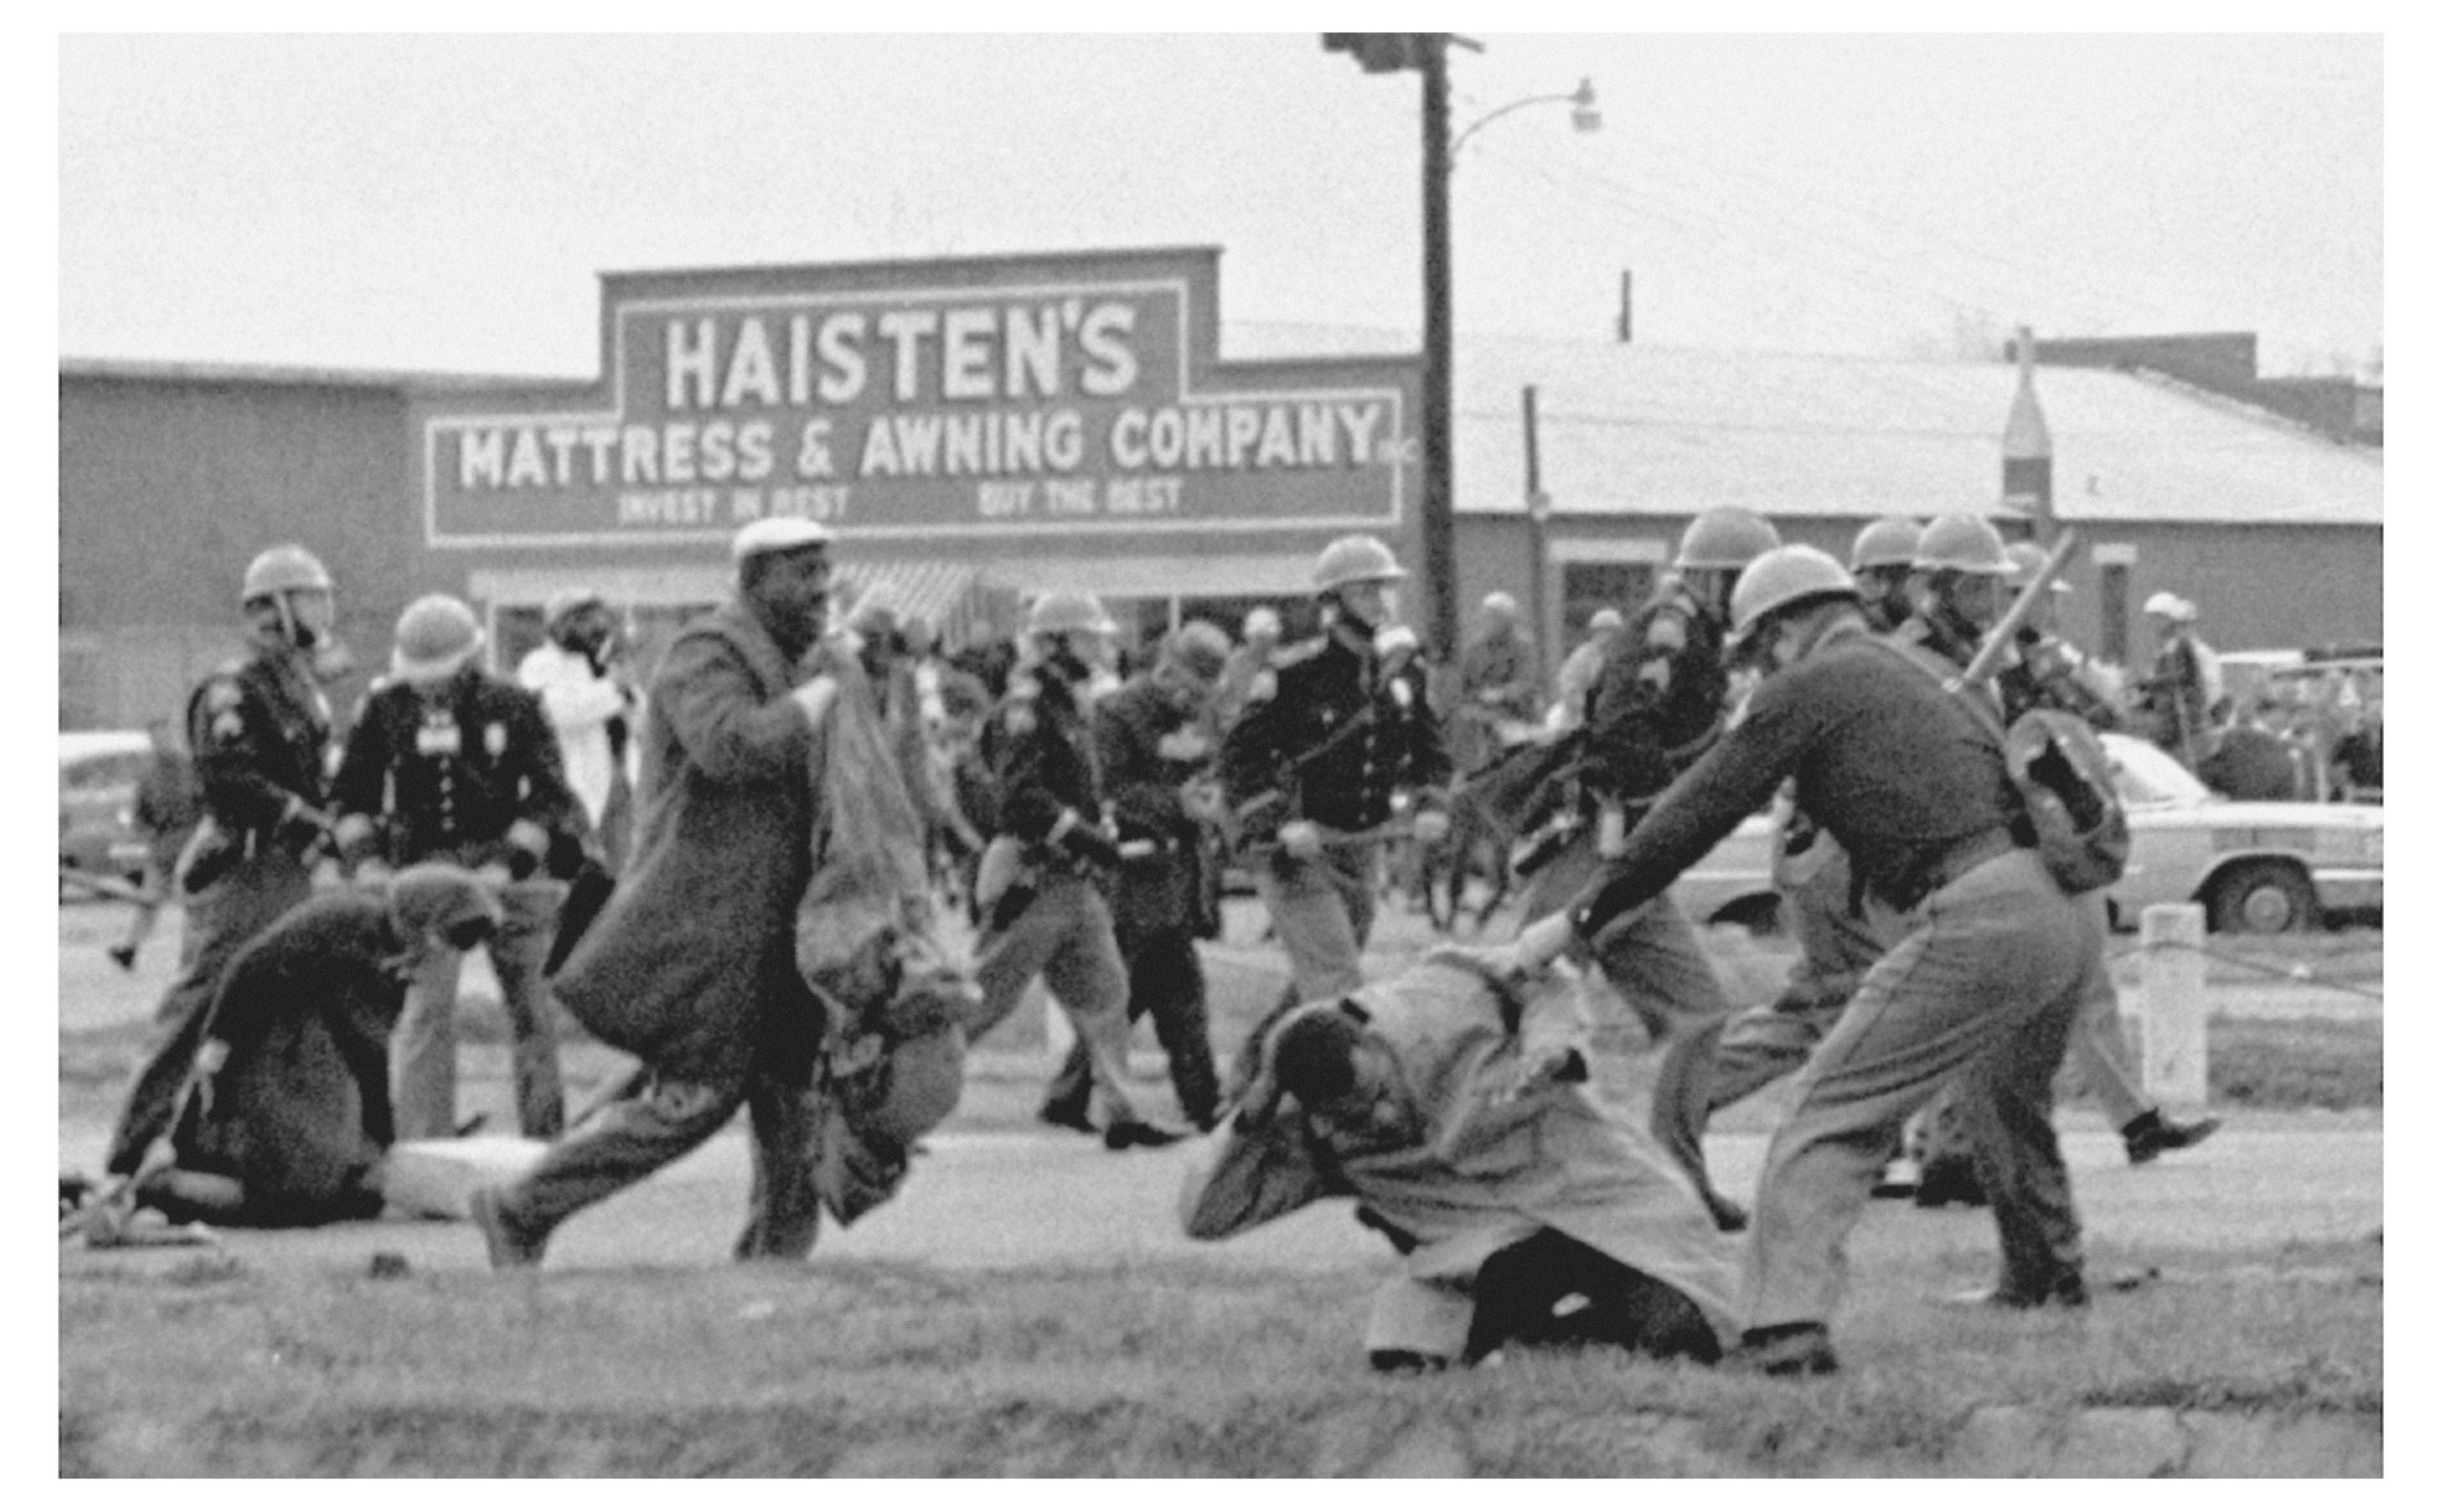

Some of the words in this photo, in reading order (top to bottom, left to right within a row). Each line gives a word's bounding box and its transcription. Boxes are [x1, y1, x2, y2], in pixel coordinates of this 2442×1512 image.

[667, 298, 1138, 408] HAISTEN'S
[460, 423, 774, 489] MATTRESS
[797, 418, 834, 478] &
[860, 409, 1085, 478] AWNING
[1110, 402, 1381, 470] COMPANY
[619, 487, 716, 524] INVEST
[978, 480, 1034, 517] BUY
[1045, 479, 1096, 514] THE
[1107, 477, 1184, 513] BEST
